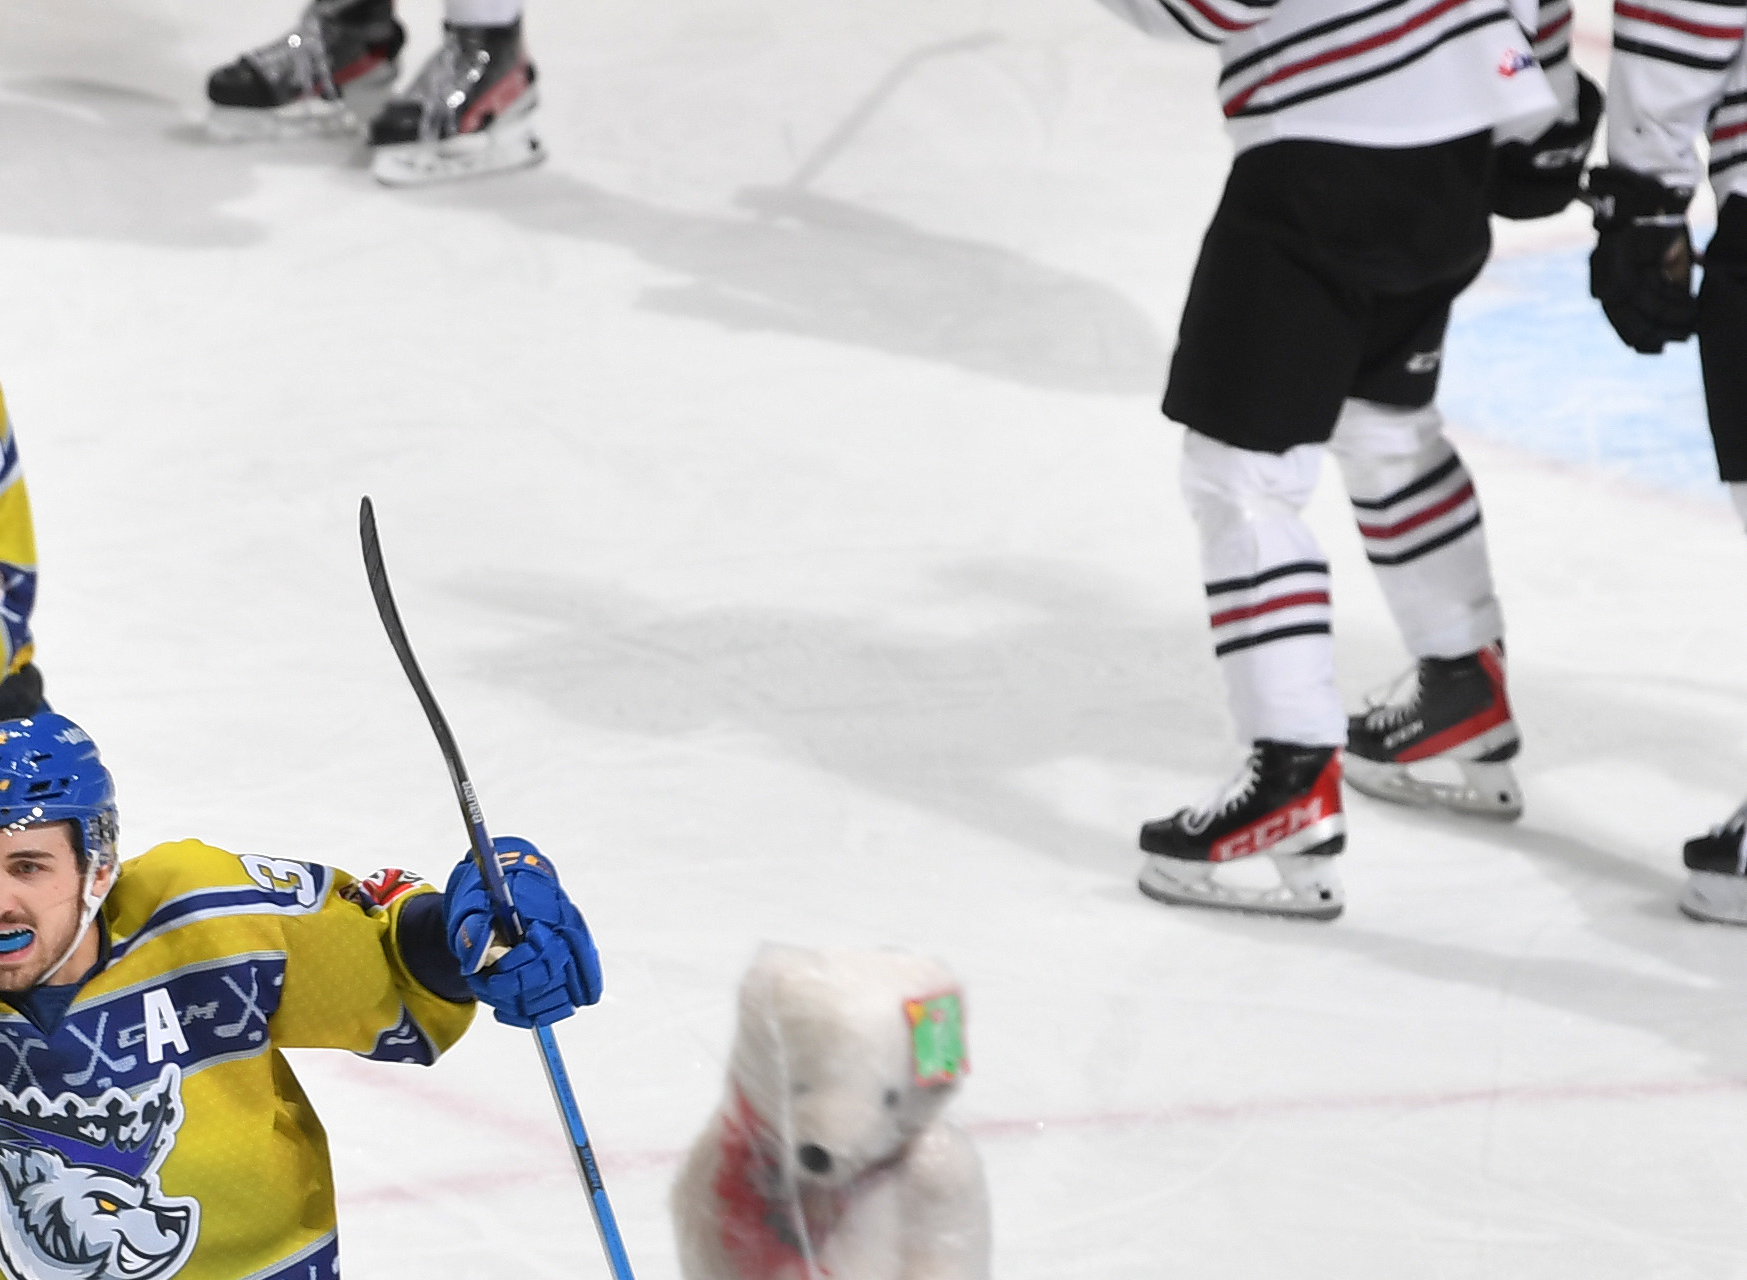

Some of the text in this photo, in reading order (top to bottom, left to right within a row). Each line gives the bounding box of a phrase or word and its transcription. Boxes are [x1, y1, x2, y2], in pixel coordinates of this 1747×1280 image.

[1220, 796, 1323, 861] CCM
[117, 1001, 220, 1050] CM
[143, 987, 190, 1064] A
